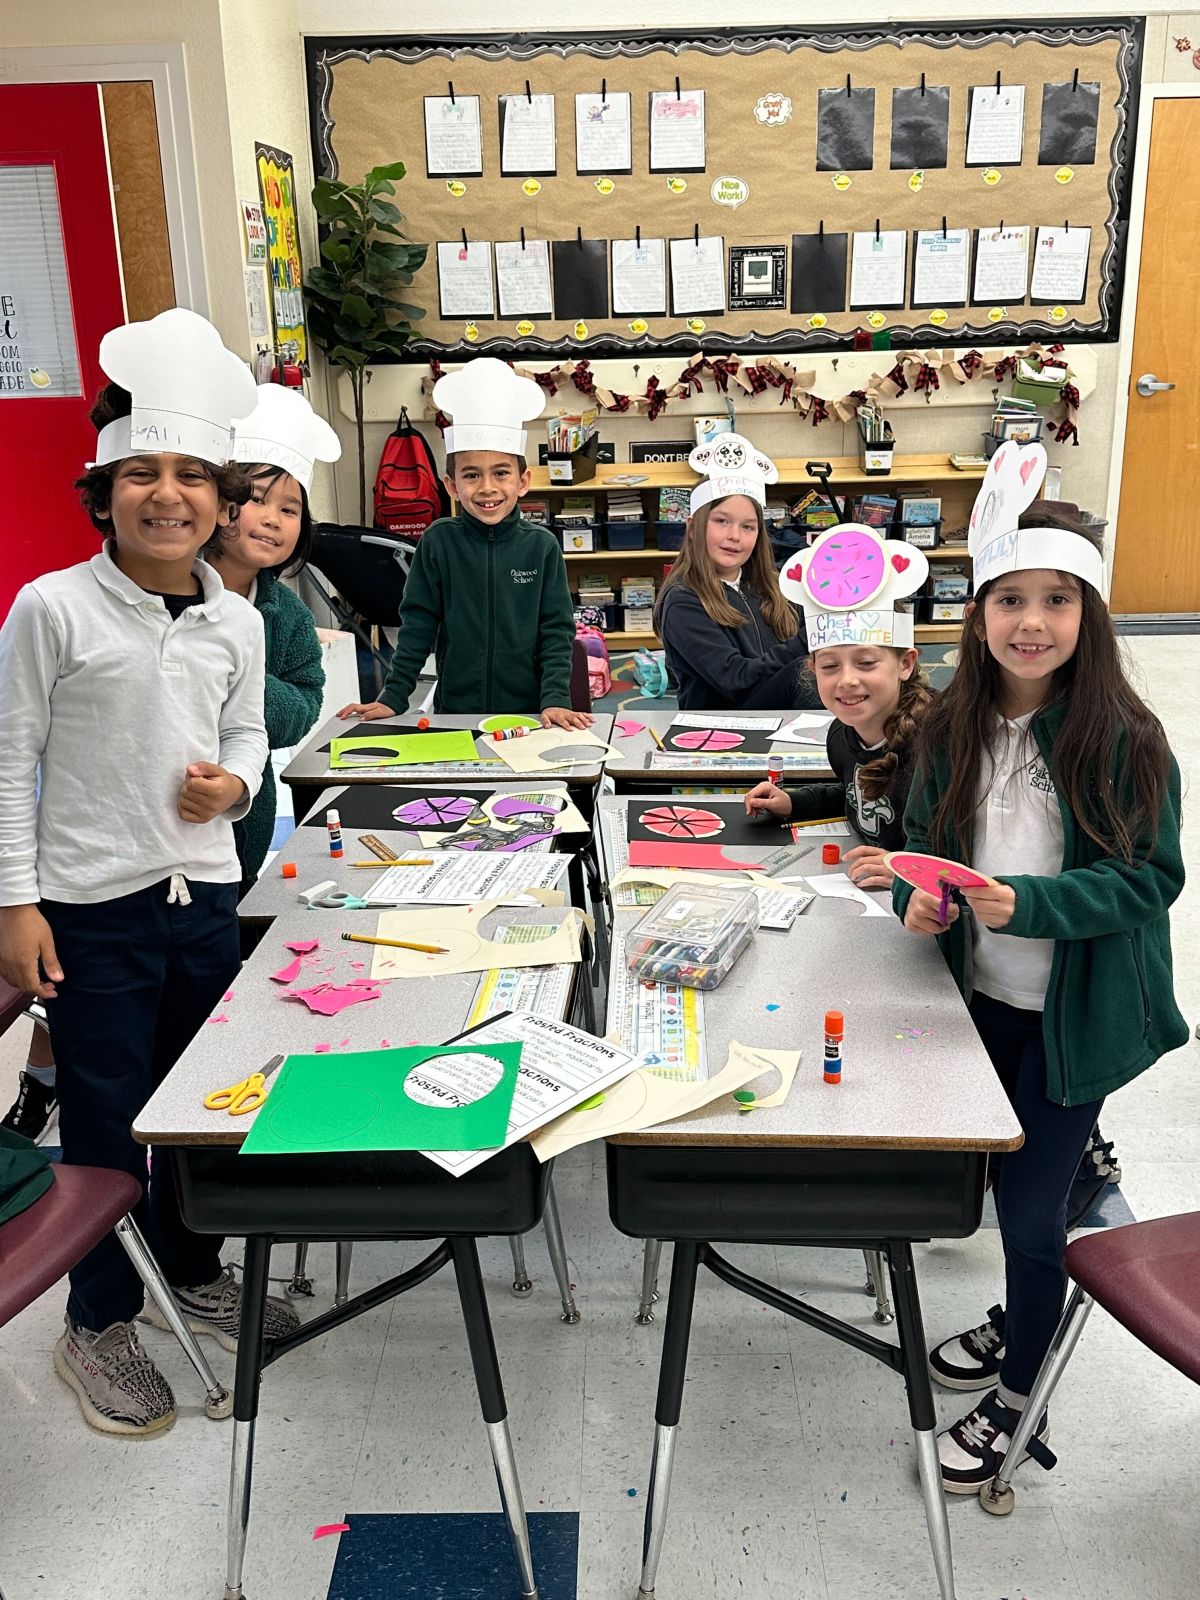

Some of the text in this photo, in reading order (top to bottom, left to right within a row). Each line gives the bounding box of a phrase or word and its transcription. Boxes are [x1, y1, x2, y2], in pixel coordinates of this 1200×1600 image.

[721, 180, 740, 190] Nice
[718, 191, 743, 201] Work!
[643, 453, 673, 464] DON'T
[390, 523, 427, 531] OAKWOOD
[816, 611, 857, 632] Chef
[809, 629, 893, 648] CHARLOTTE
[523, 1016, 616, 1059] Frosted Fractions
[406, 1075, 449, 1099] Frosted
